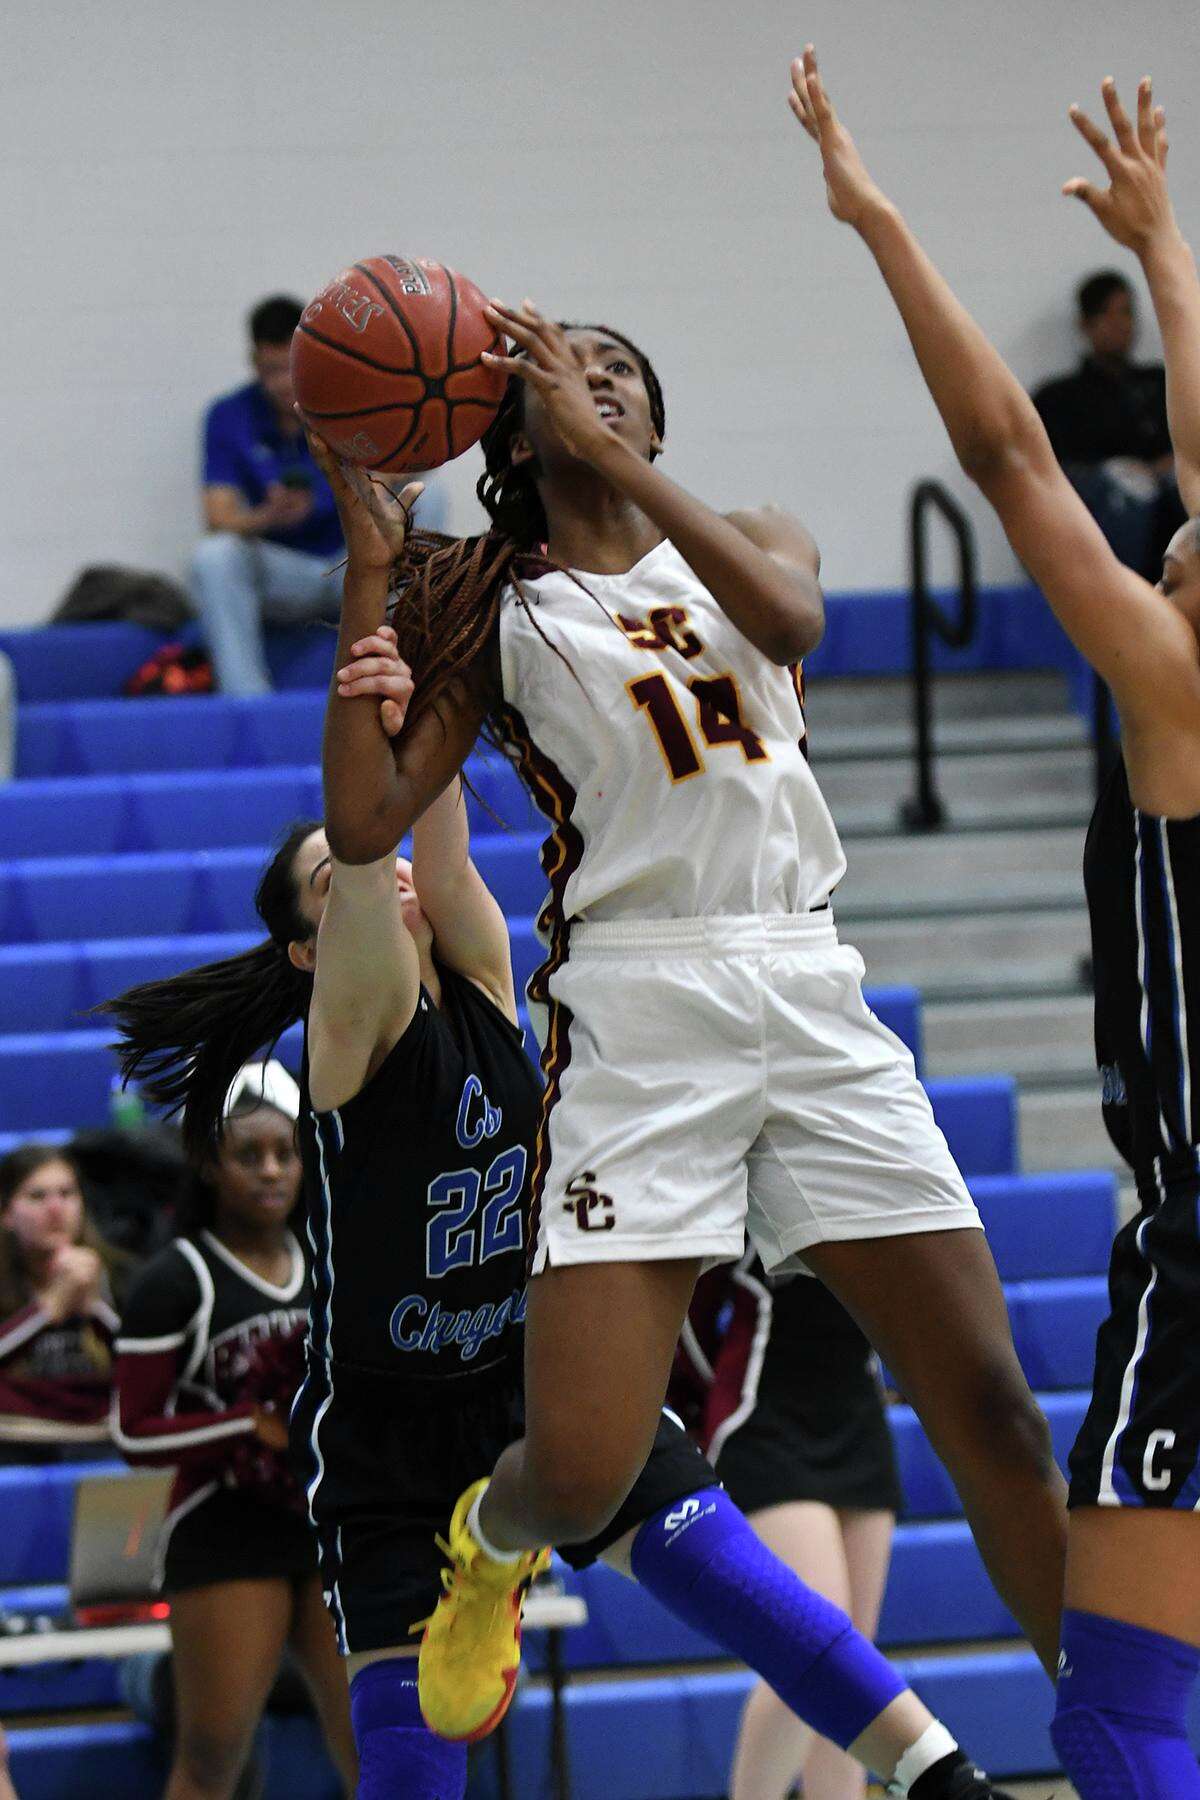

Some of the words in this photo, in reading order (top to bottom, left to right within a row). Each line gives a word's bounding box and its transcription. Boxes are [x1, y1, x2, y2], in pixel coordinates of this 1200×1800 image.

[624, 668, 773, 786] 14
[425, 1144, 528, 1279] 22
[562, 1170, 616, 1232] SC
[1142, 1427, 1177, 1492] C
